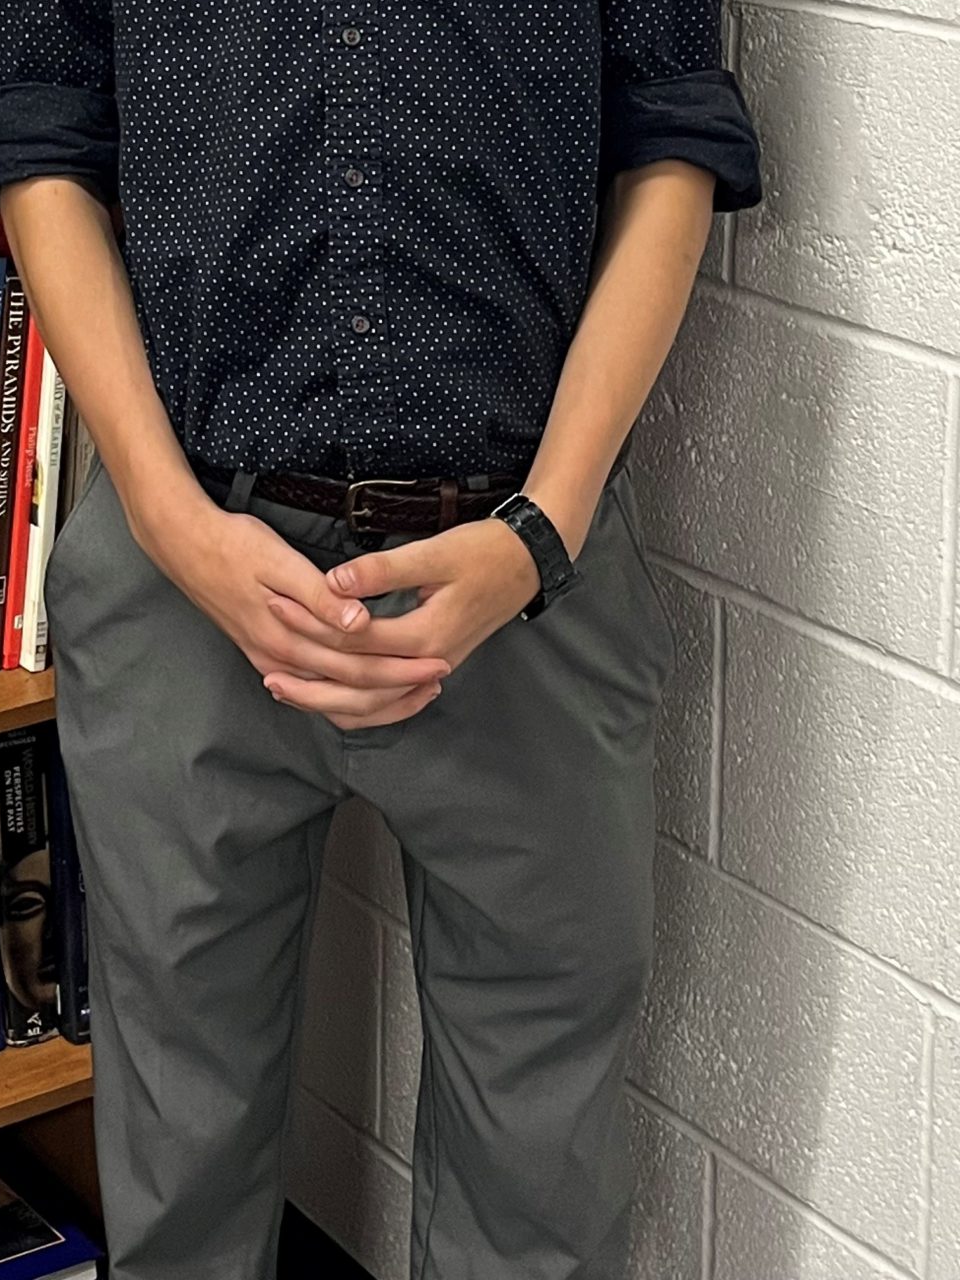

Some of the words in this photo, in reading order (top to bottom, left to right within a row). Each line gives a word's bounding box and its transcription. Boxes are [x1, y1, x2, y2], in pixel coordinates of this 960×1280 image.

[8, 291, 24, 329] THE
[0, 335, 23, 434] PYRAMIDS
[0, 440, 12, 468] AND
[4, 770, 12, 786] ON
[6, 788, 14, 806] THE
[13, 765, 25, 834] PERSPECTIVES
[6, 809, 17, 833] PAST
